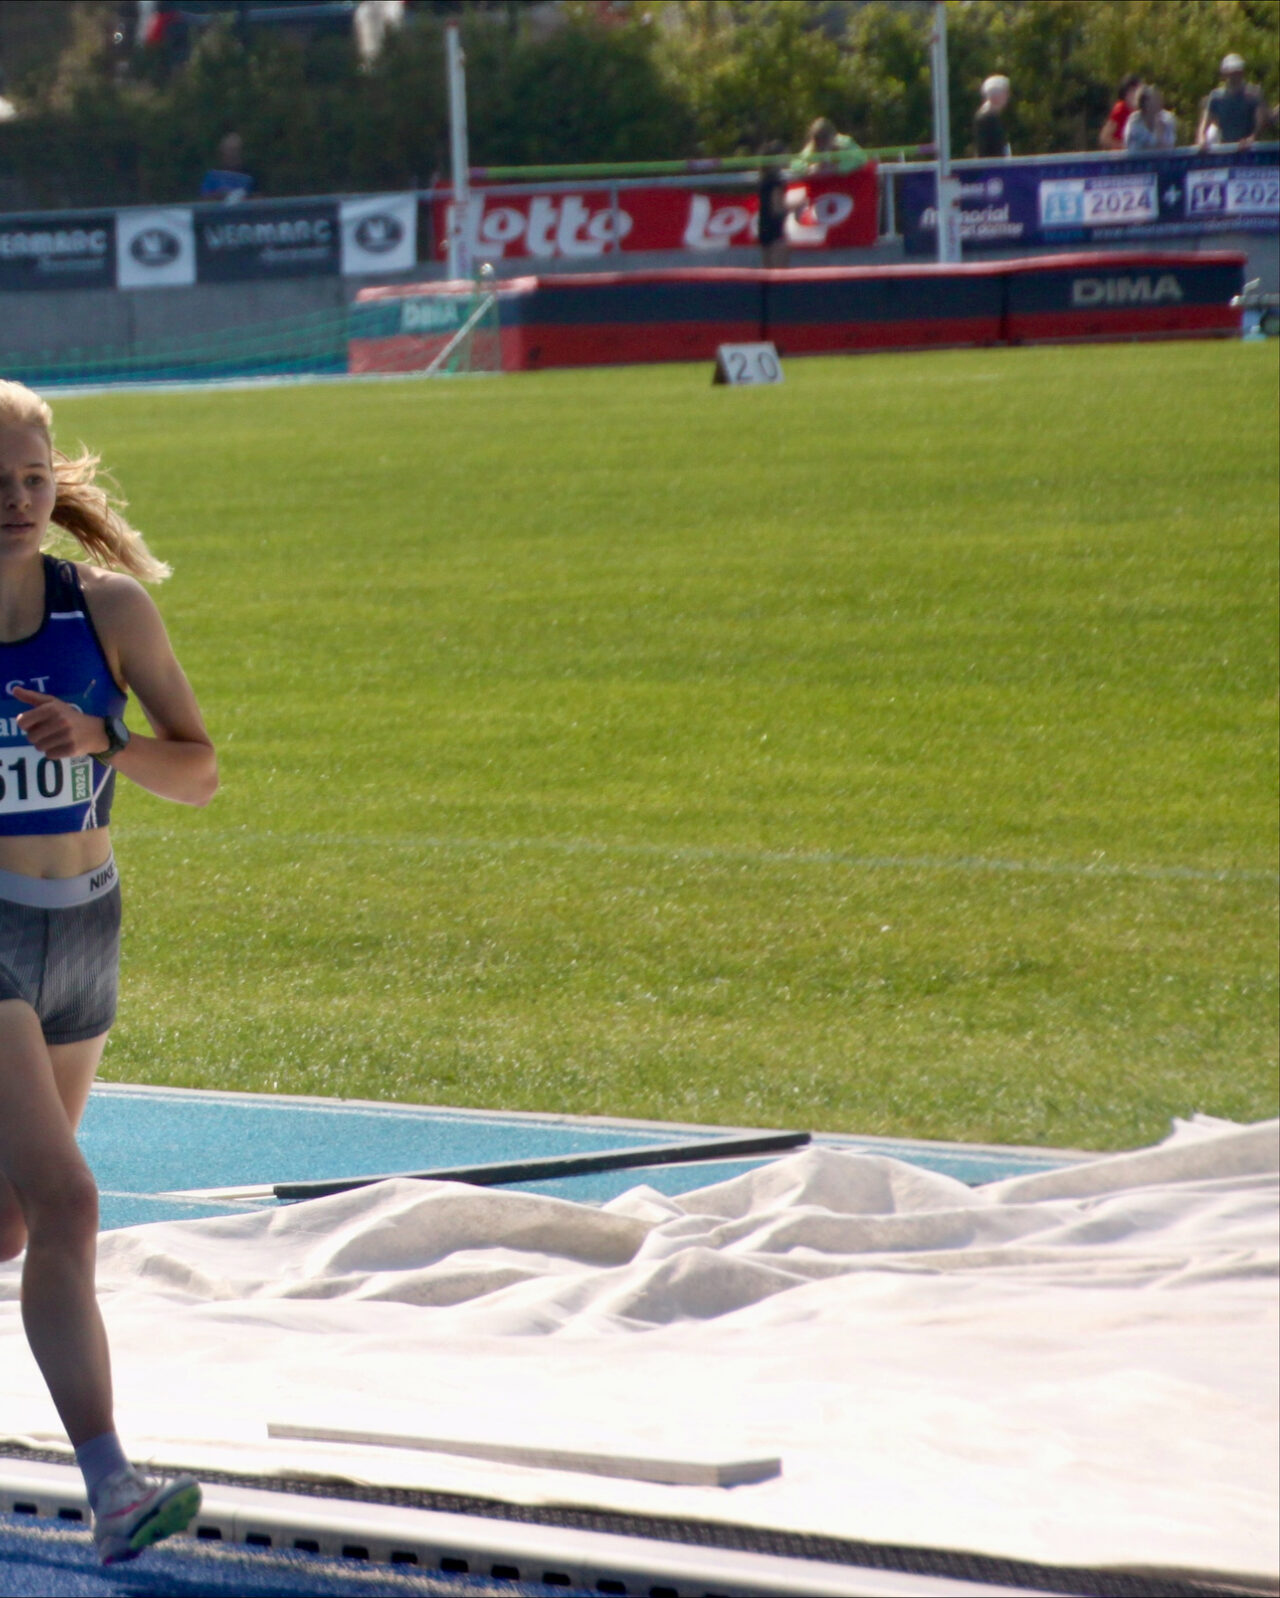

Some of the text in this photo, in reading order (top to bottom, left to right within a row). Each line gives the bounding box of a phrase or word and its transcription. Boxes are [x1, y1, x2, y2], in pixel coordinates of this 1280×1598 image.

[1091, 187, 1151, 215] 2024
[458, 192, 634, 259] Lotto
[1072, 275, 1183, 305] DIMA
[730, 351, 778, 384] 20
[75, 767, 87, 799] 2024
